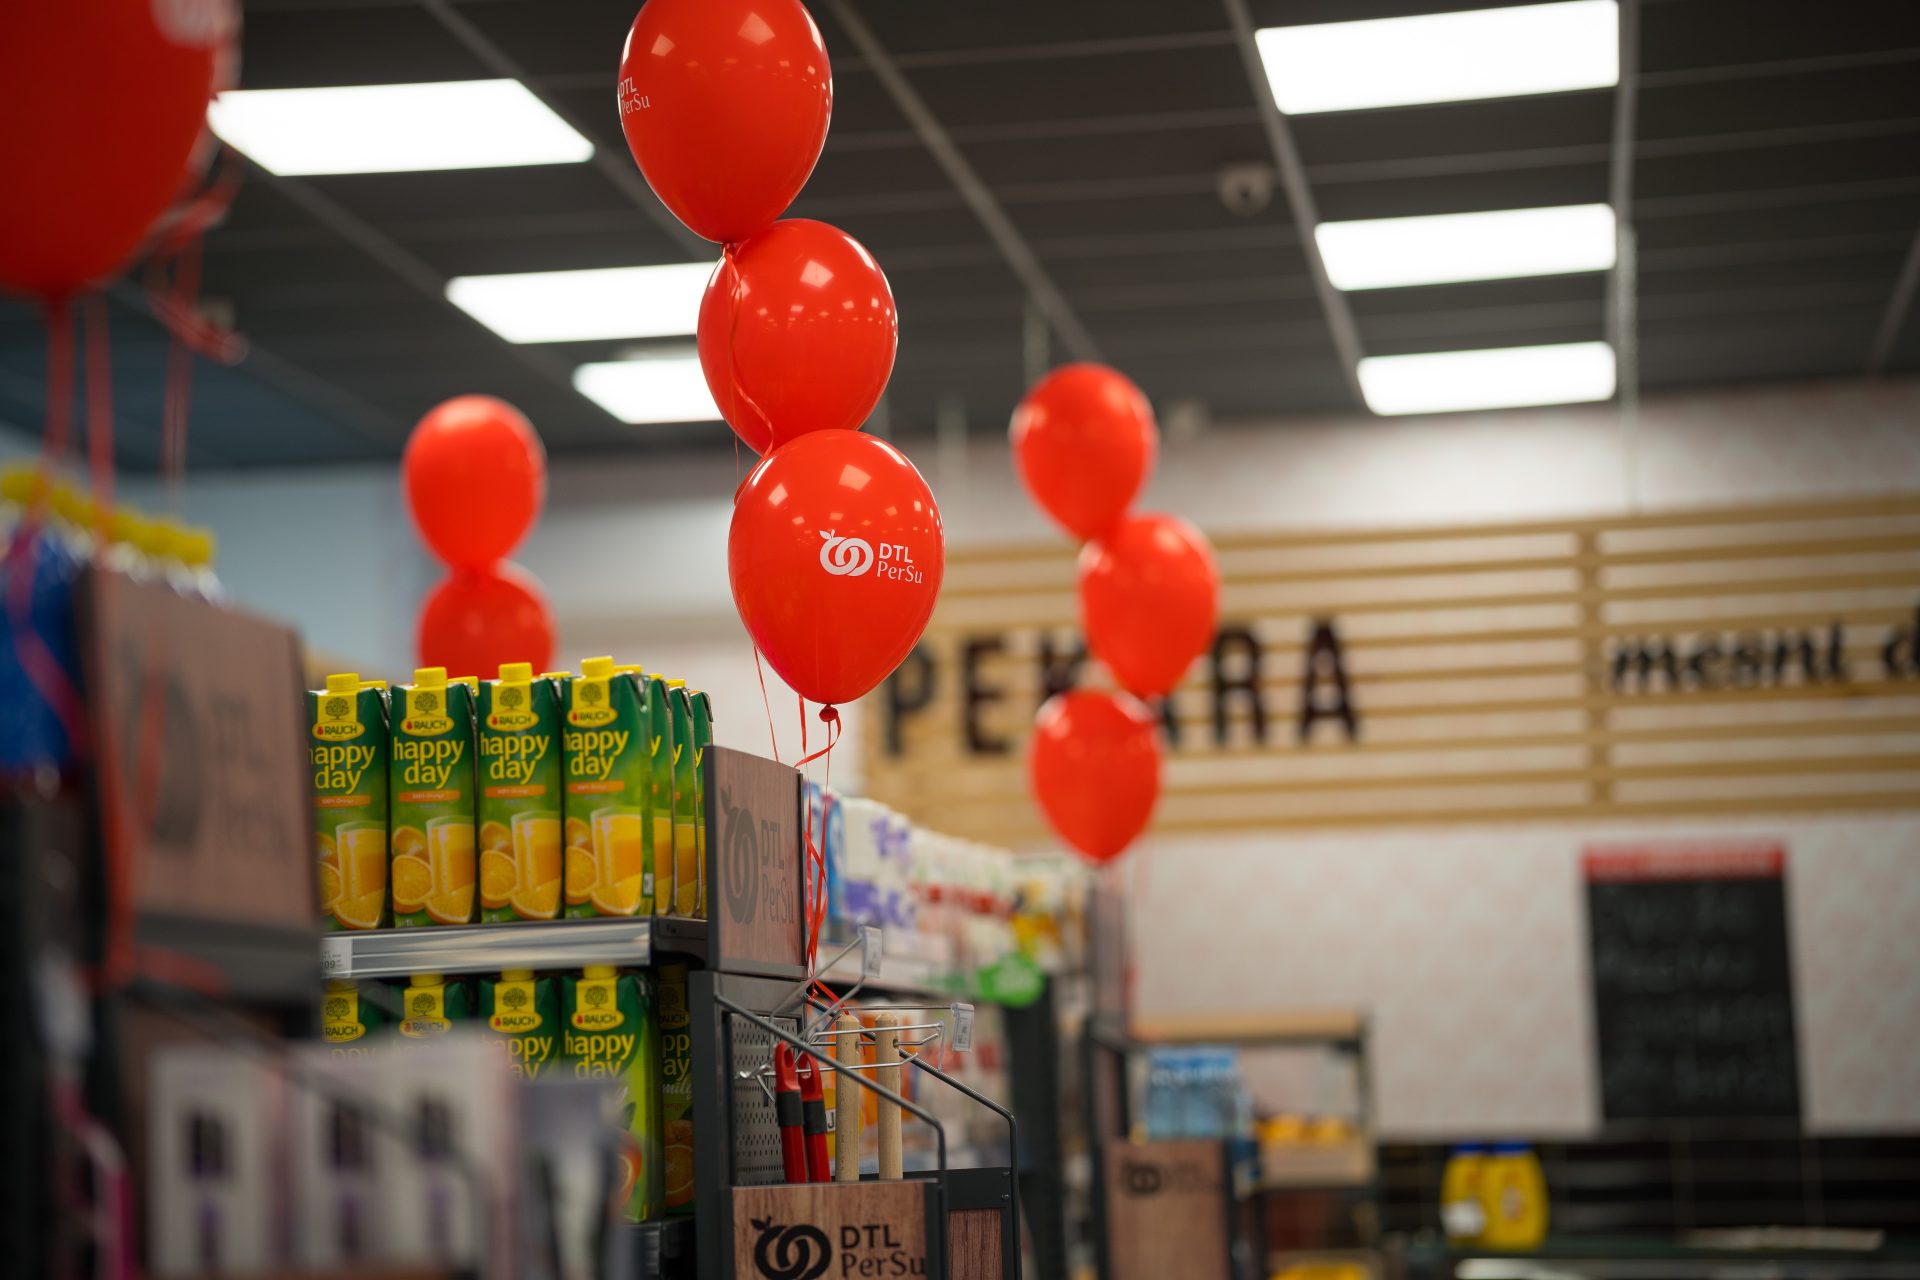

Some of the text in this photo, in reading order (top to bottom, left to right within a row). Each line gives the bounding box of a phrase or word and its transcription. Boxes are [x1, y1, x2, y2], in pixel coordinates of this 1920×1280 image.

[619, 76, 638, 98] DTL
[621, 93, 650, 116] PerSu
[879, 542, 914, 564] DTL
[876, 560, 923, 584] PerSu
[413, 719, 447, 730] RAUCH
[498, 716, 532, 726] RAUCH
[578, 711, 610, 721] RAUCH
[324, 724, 358, 736] RAUCH
[563, 727, 630, 757] happy
[393, 736, 465, 766] happy
[480, 731, 550, 761] happy
[404, 760, 452, 790] day
[489, 755, 537, 785] day
[570, 751, 616, 781] day
[314, 765, 362, 795] day
[761, 818, 785, 871] DTL
[761, 873, 795, 925] PerSu
[325, 1025, 359, 1037] RAUCH
[413, 1021, 444, 1032] RAUCH
[502, 1016, 536, 1027] RAUCH
[583, 1013, 617, 1024] RAUCH
[564, 1029, 636, 1061] happy
[574, 1055, 623, 1081] day
[663, 1057, 691, 1082] ay
[840, 1223, 902, 1249] DTL
[840, 1249, 927, 1279] PerSu
